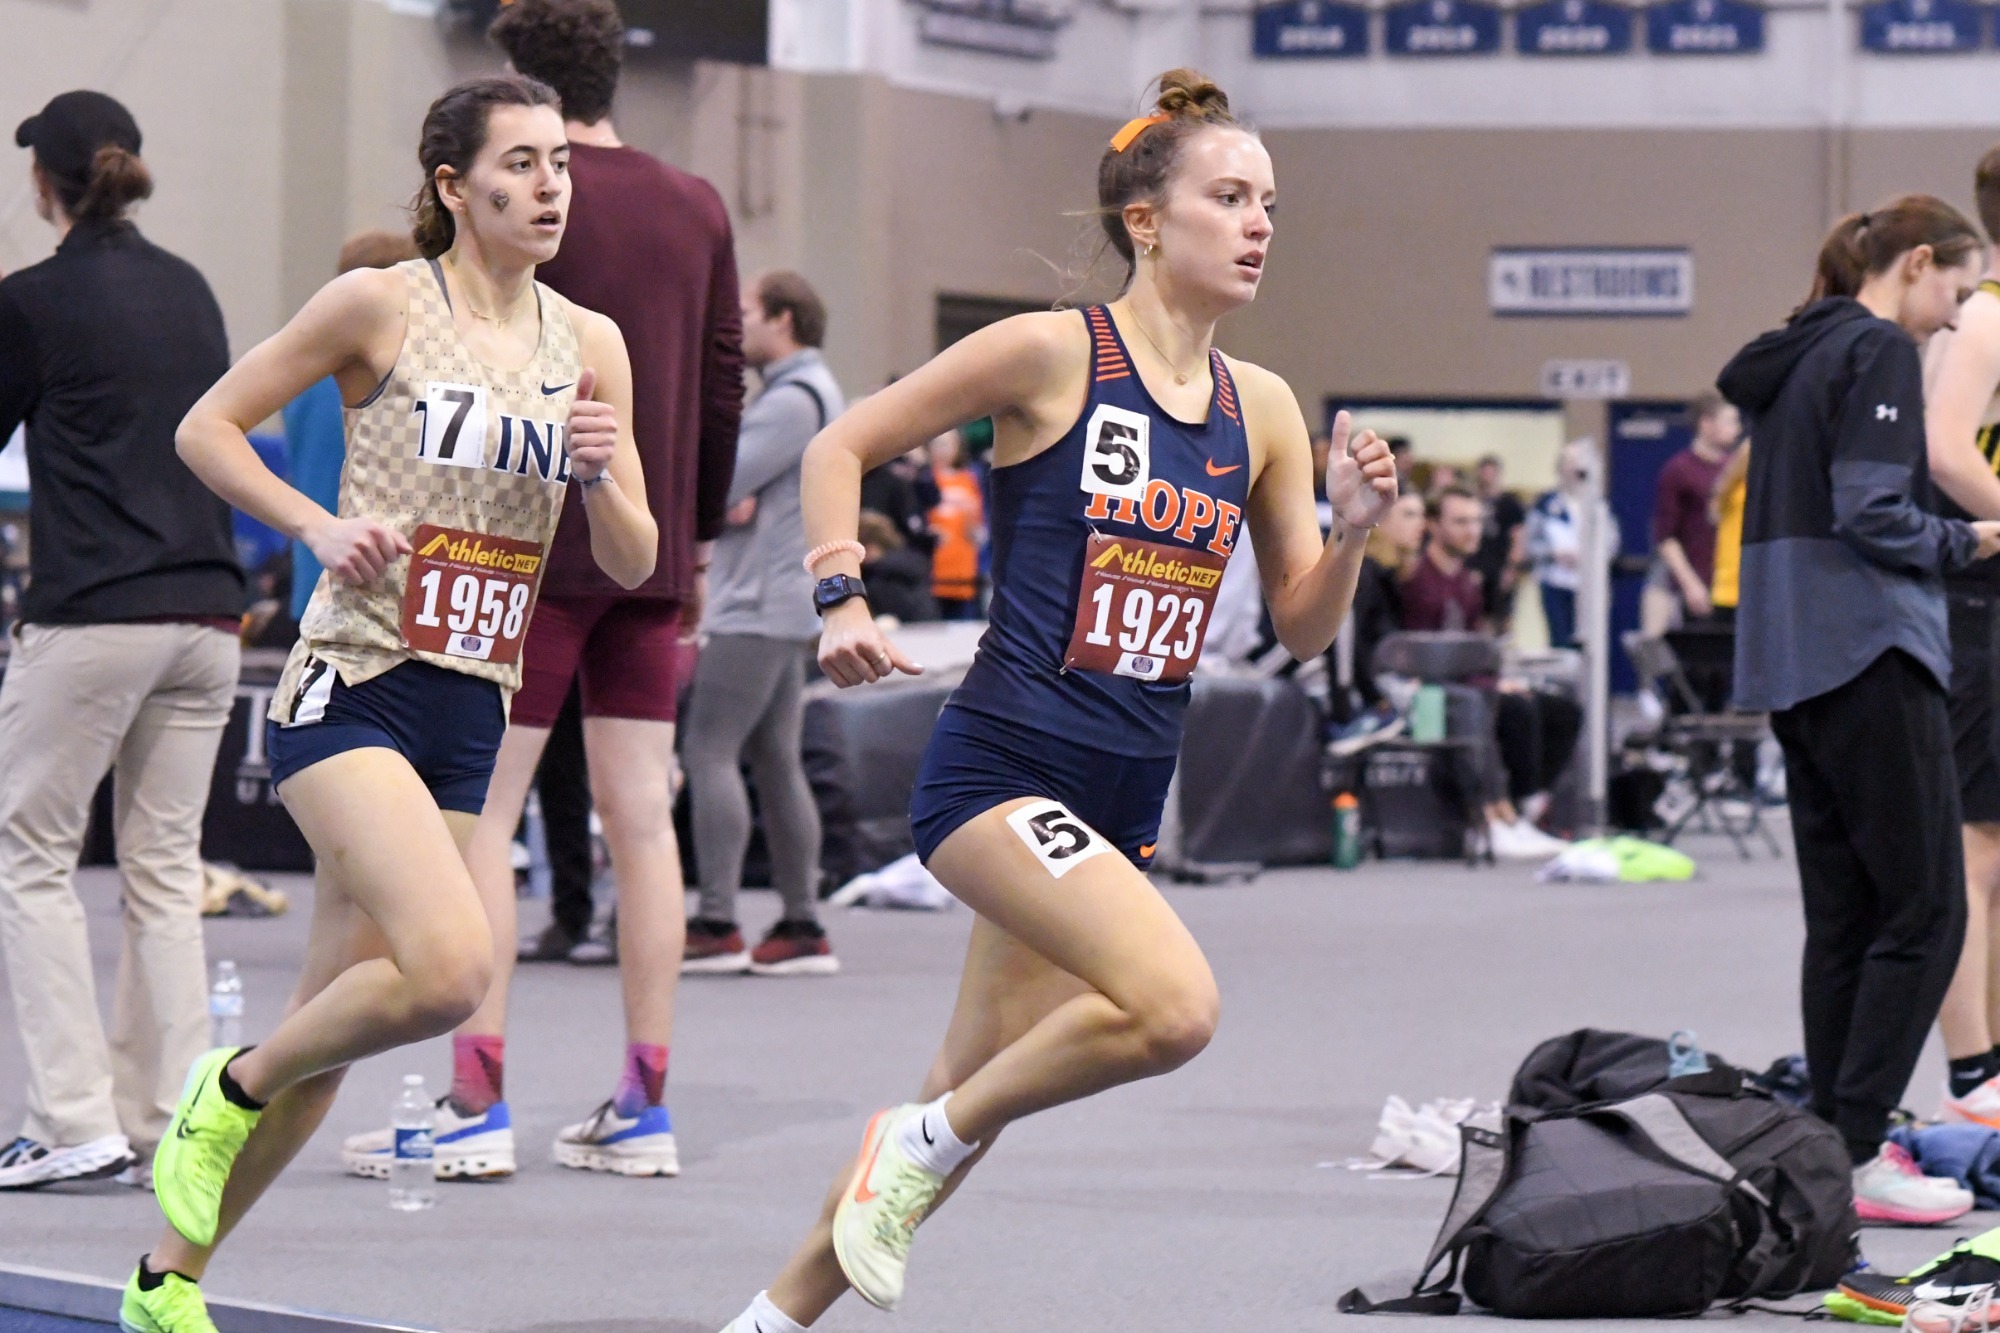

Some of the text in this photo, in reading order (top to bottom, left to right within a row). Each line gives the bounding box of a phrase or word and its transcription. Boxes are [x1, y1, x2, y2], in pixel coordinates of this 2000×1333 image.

[1530, 266, 1680, 298] RESTROOMS
[1550, 365, 1620, 388] EXIT
[431, 387, 475, 459] 7
[1091, 419, 1141, 486] 5
[415, 569, 530, 640] 1958
[1085, 583, 1205, 660] 1923
[1027, 810, 1091, 860] 5
